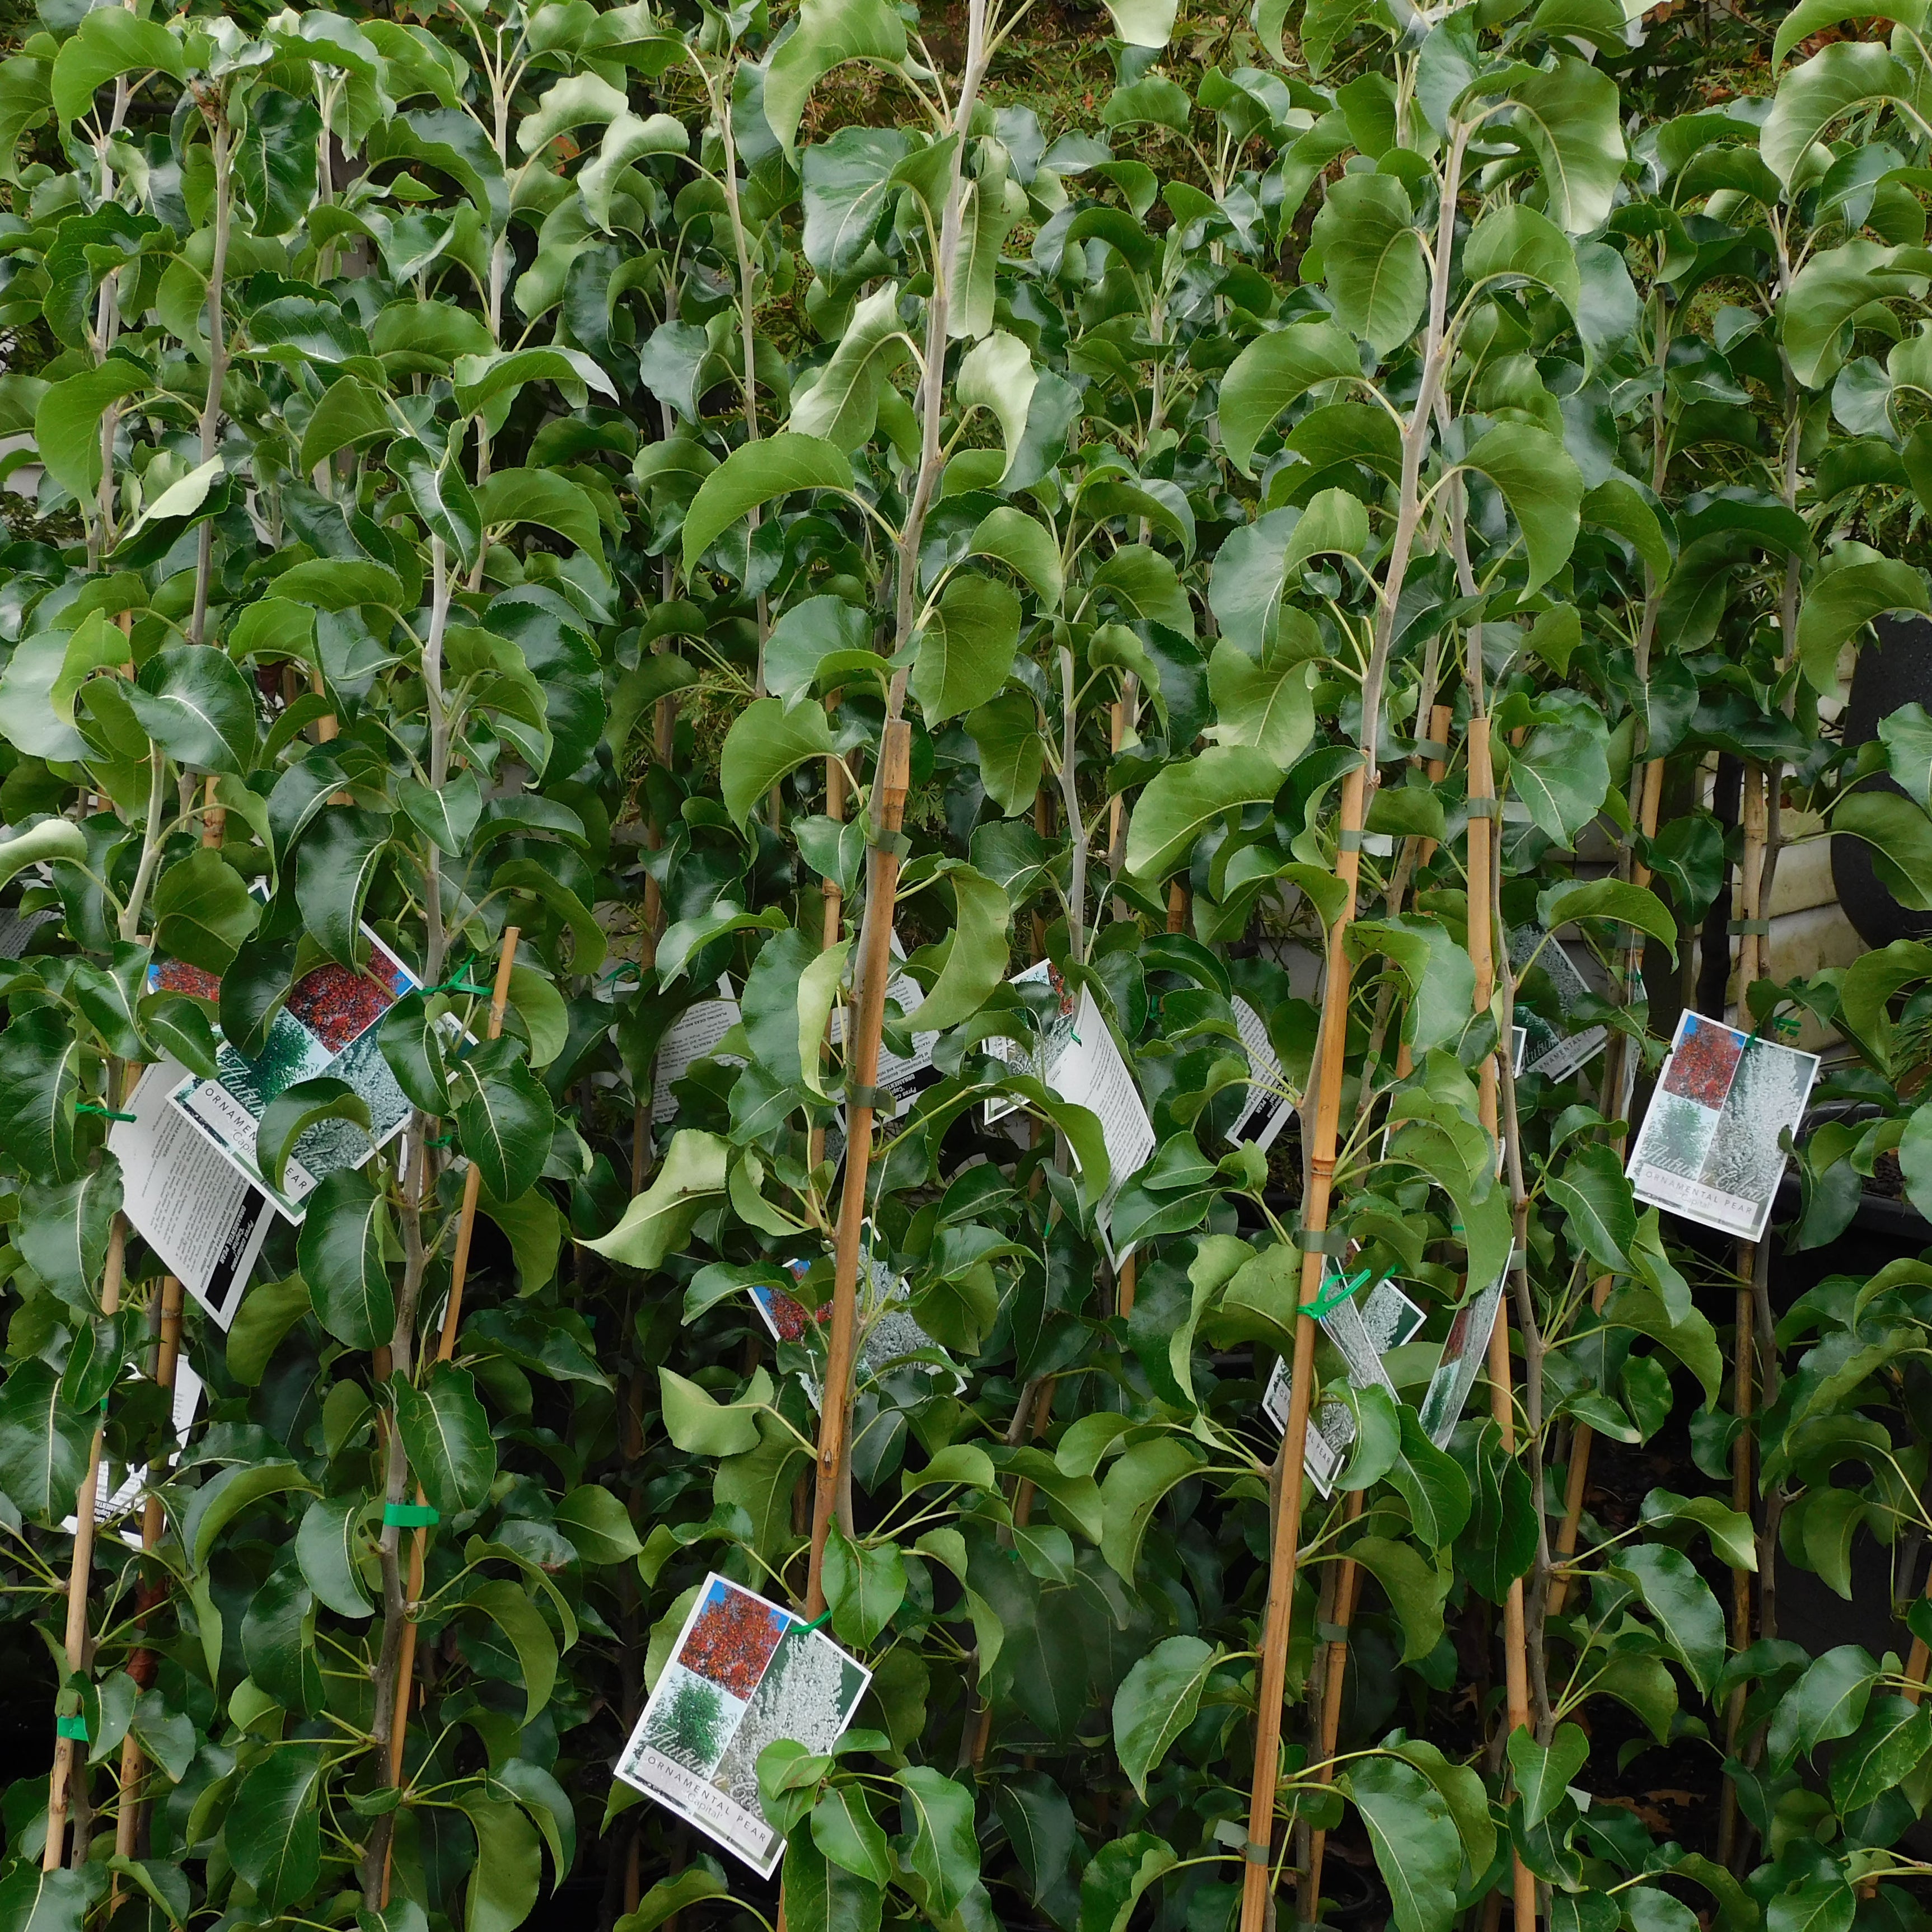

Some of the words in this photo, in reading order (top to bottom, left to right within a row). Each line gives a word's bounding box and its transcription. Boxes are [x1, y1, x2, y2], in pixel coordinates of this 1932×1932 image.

[901, 1087, 916, 1097] Pyrus
[1255, 1099, 1267, 1114] PEAR
[1266, 1096, 1283, 1119] alleryana
[204, 1086, 258, 1142] ORNAMEN
[285, 1167, 308, 1190] EAR
[1644, 1170, 1719, 1203] ORNAMENTAL
[1724, 1199, 1752, 1214] PEAR
[226, 1204, 246, 1246] ORNAMENTAL
[218, 1245, 229, 1264] PEAR
[647, 1755, 732, 1816] ORNAMENTAL
[736, 1814, 767, 1842] PEAR
